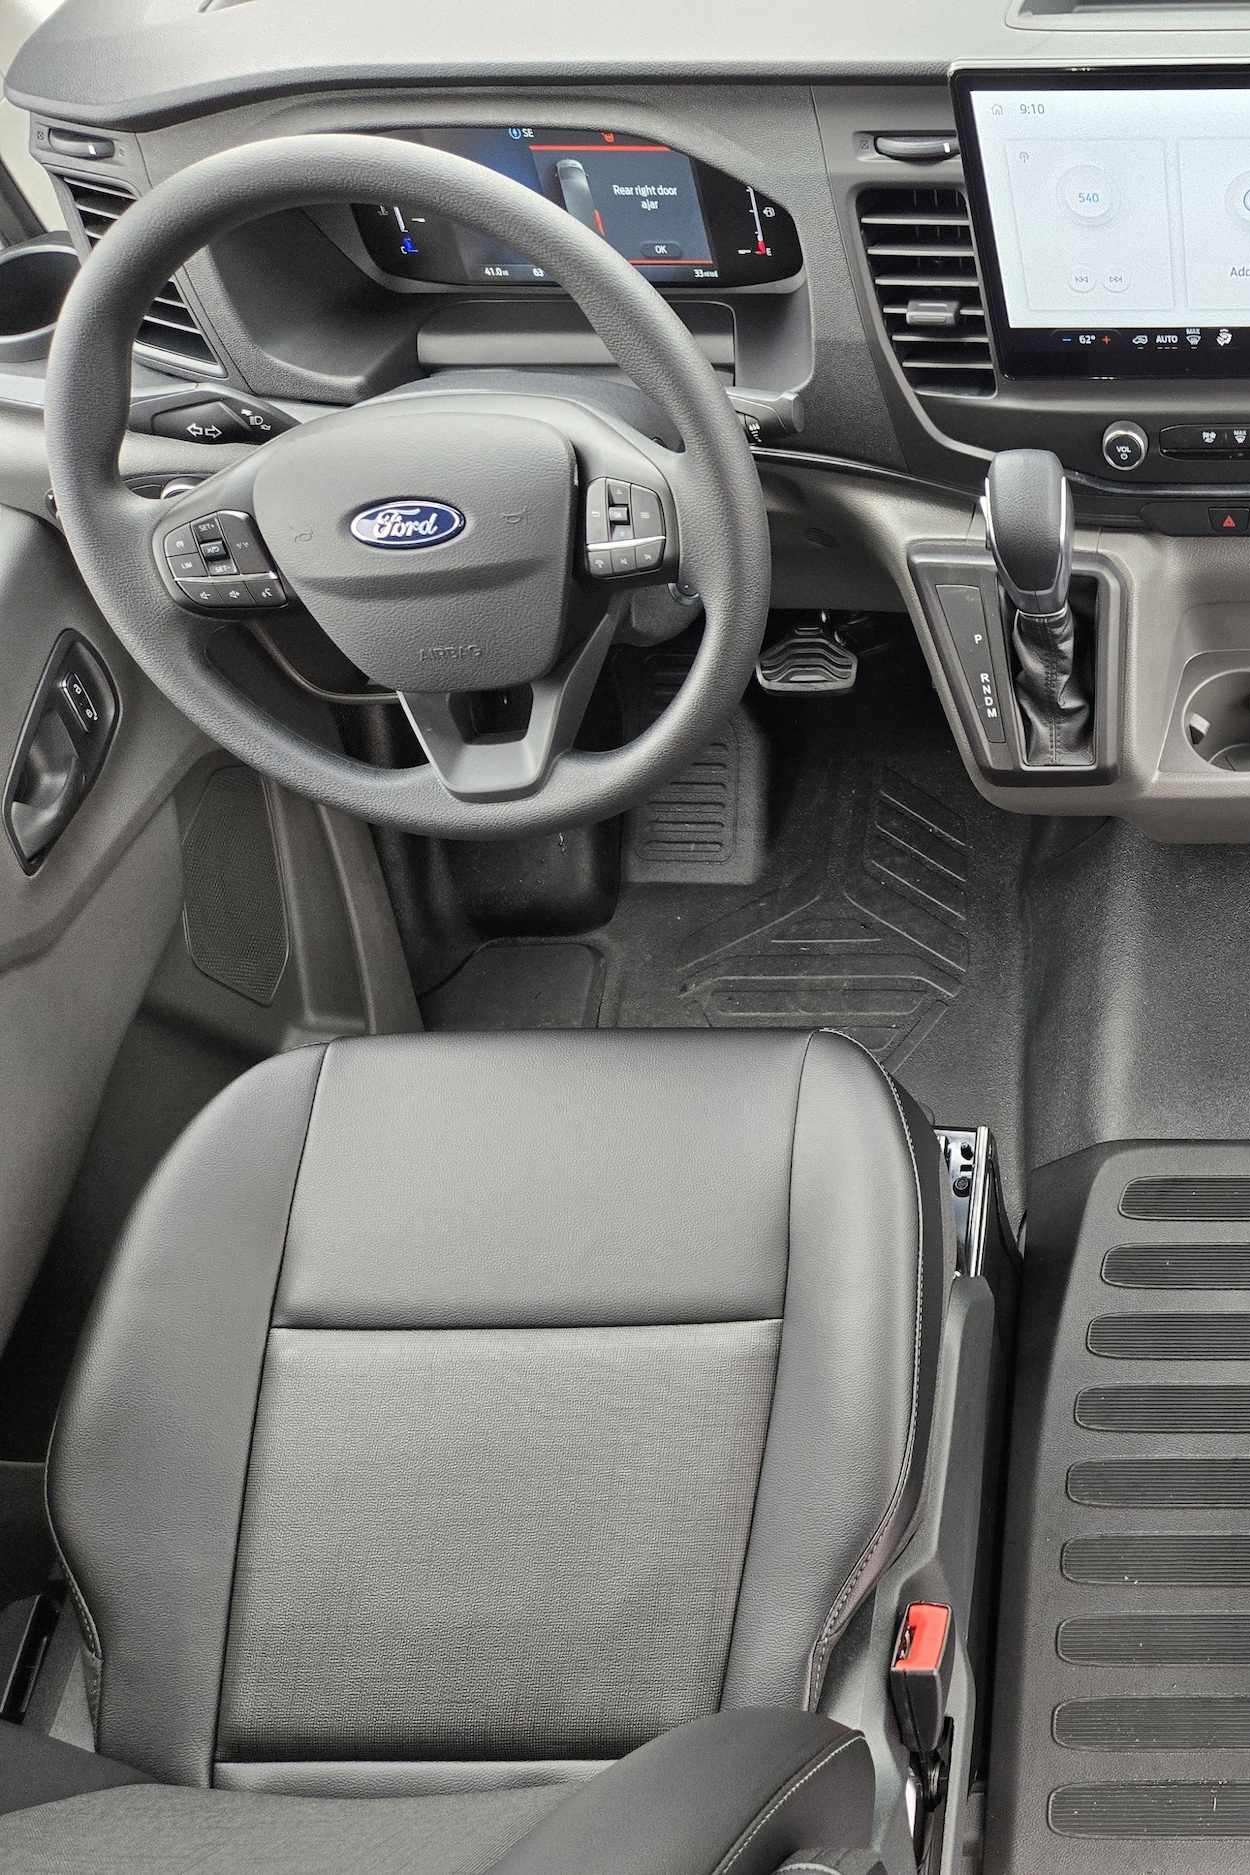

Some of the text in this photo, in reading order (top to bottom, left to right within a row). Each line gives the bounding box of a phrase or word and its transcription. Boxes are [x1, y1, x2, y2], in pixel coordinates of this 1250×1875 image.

[1019, 103, 1045, 115] 9:10
[521, 128, 534, 138] SE
[612, 184, 678, 197] Rear right door
[1078, 192, 1100, 204] 540
[641, 198, 659, 211] ajar
[654, 244, 668, 254] OK
[765, 247, 773, 256] E
[1155, 334, 1179, 344] AUTO
[1115, 445, 1132, 453] VOL
[613, 511, 623, 519] OK
[372, 508, 439, 541] Ford
[180, 561, 193, 570] LIM
[974, 634, 983, 645] P
[980, 672, 991, 684] R
[982, 684, 992, 695] N
[984, 696, 994, 707] D
[987, 707, 998, 718] M
